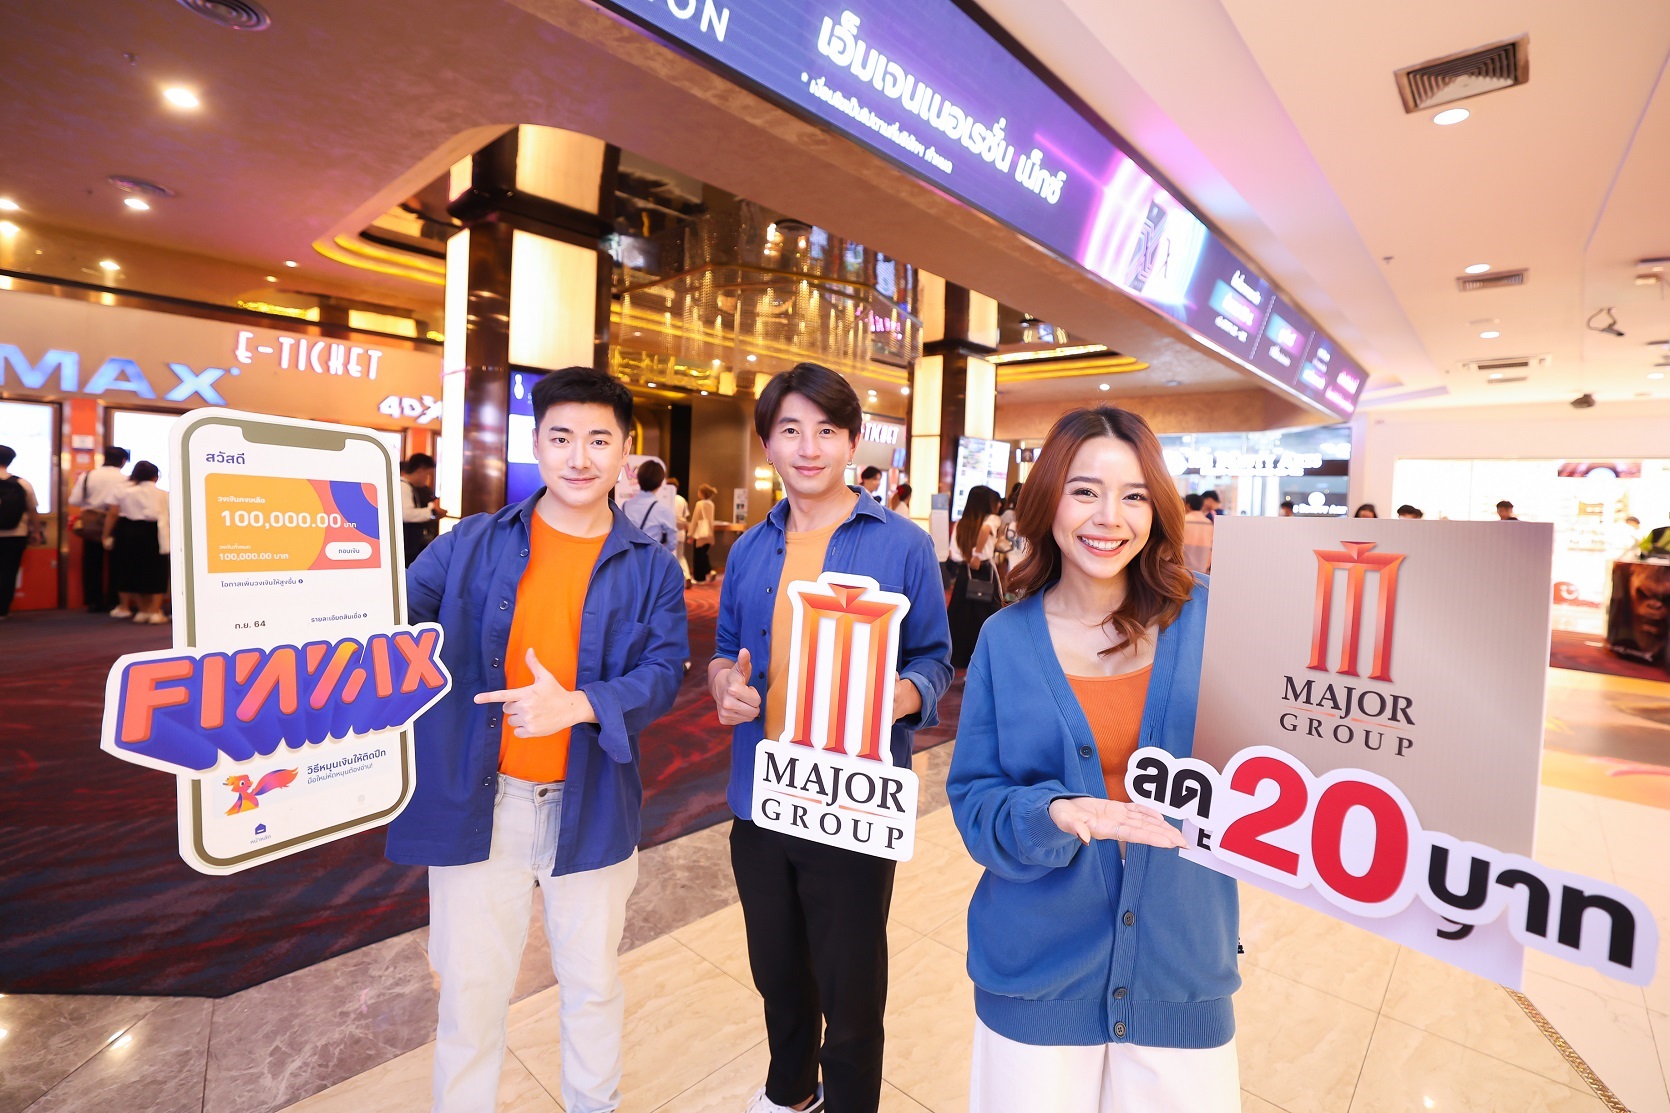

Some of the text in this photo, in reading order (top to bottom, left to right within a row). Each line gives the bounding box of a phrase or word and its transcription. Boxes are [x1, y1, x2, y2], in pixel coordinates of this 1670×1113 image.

[649, 0, 730, 42] ON
[817, 10, 1014, 173] เอ็มเจนเนอเรชั่น
[234, 331, 382, 380] E-TICKET
[379, 395, 442, 424] 4DX
[205, 451, 246, 465] สวัสดี
[217, 495, 266, 504] วงเงินคงเหลือ
[221, 510, 342, 529] 100,000.00
[219, 552, 272, 561] 100,000.00
[254, 620, 266, 628] 64
[311, 611, 362, 622] รายละเอียดสินเชื่อ
[1281, 675, 1415, 725] MAJOR
[1279, 712, 1414, 757] GROUP
[307, 749, 387, 775] วิธีหมุนเงินให้ติดปีก
[307, 763, 373, 784] มือใหม่หัดหมุนต้องอ่าน!
[762, 751, 906, 813] MAJOR
[761, 798, 904, 850] GROUP
[1133, 756, 1635, 969] ลด 20 บาท
